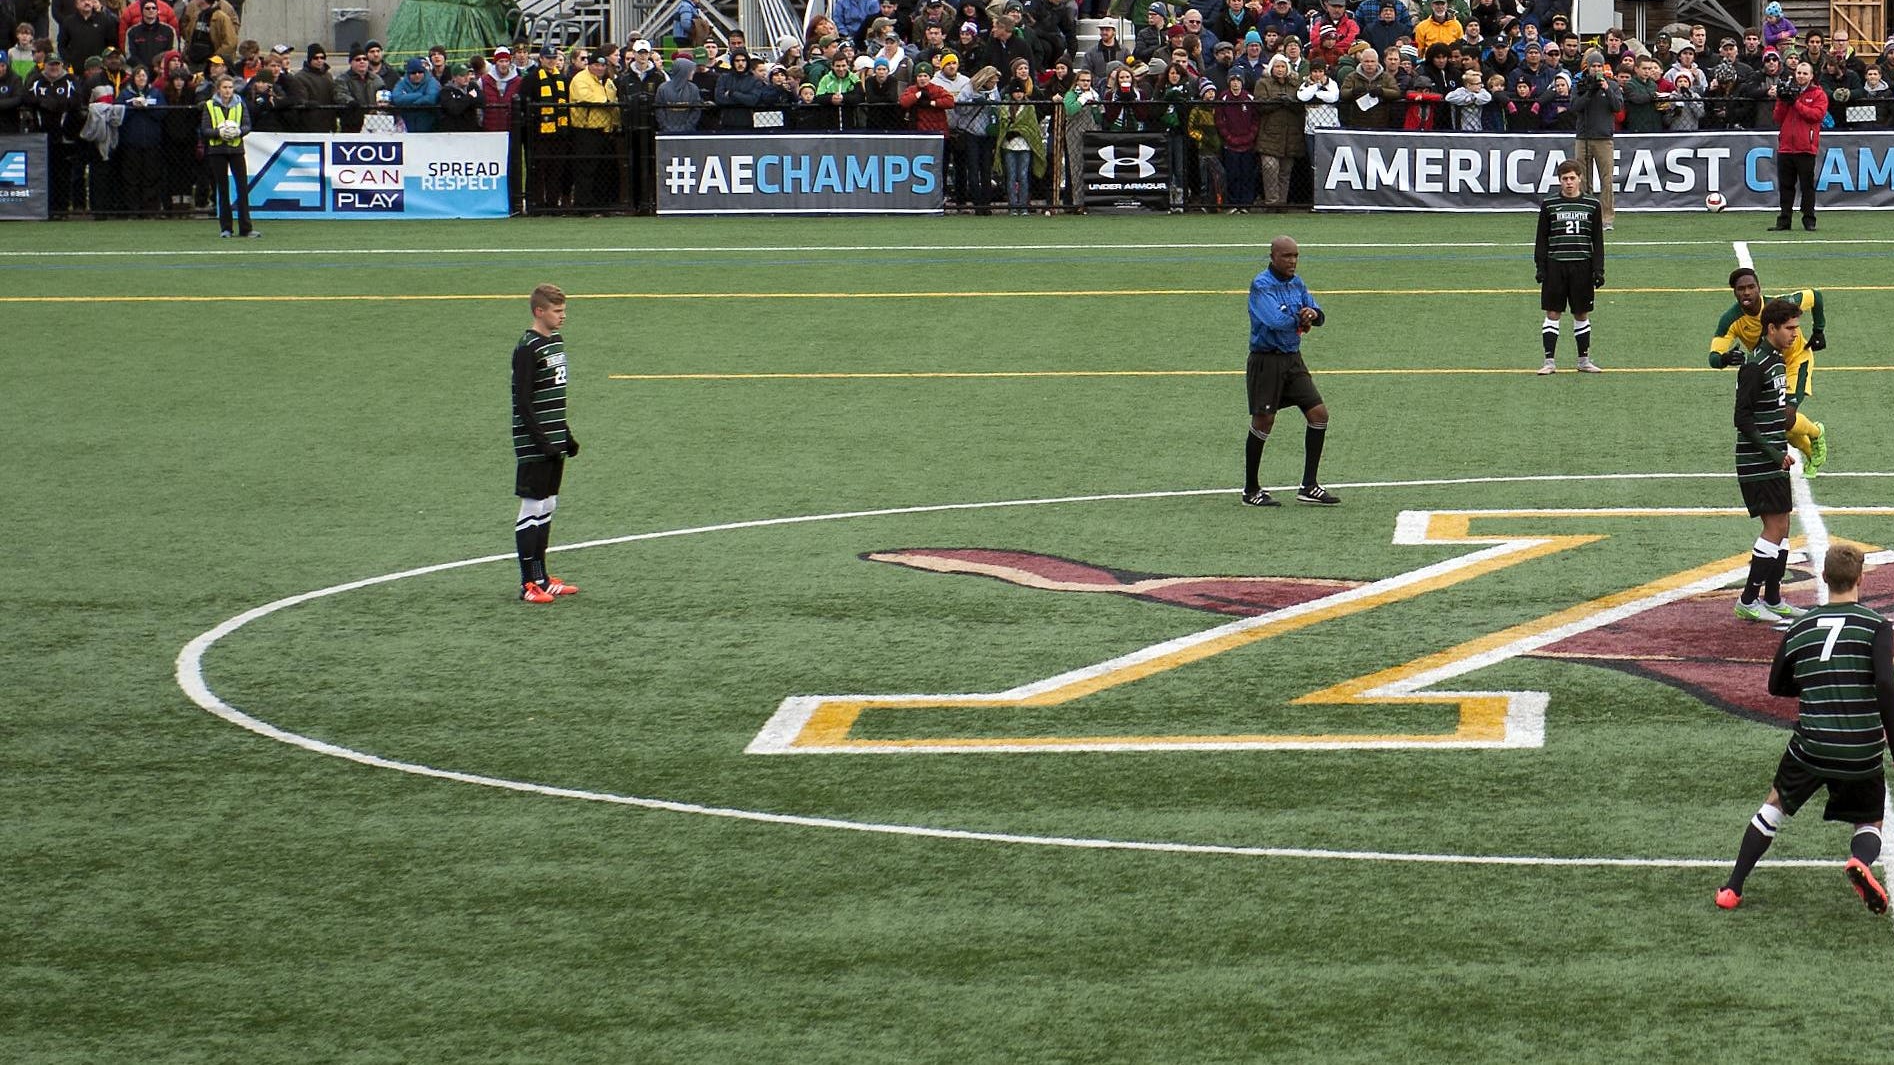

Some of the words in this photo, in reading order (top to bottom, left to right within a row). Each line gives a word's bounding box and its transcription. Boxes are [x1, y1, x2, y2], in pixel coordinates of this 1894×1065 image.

[339, 145, 396, 162] YOU
[338, 169, 399, 184] CAN
[428, 163, 500, 177] SPREAD
[666, 155, 935, 194] #AECHAMPS
[421, 175, 499, 191] RESPECT
[338, 193, 400, 208] PLAY
[1565, 221, 1580, 234] 21
[1816, 617, 1846, 662] 7
